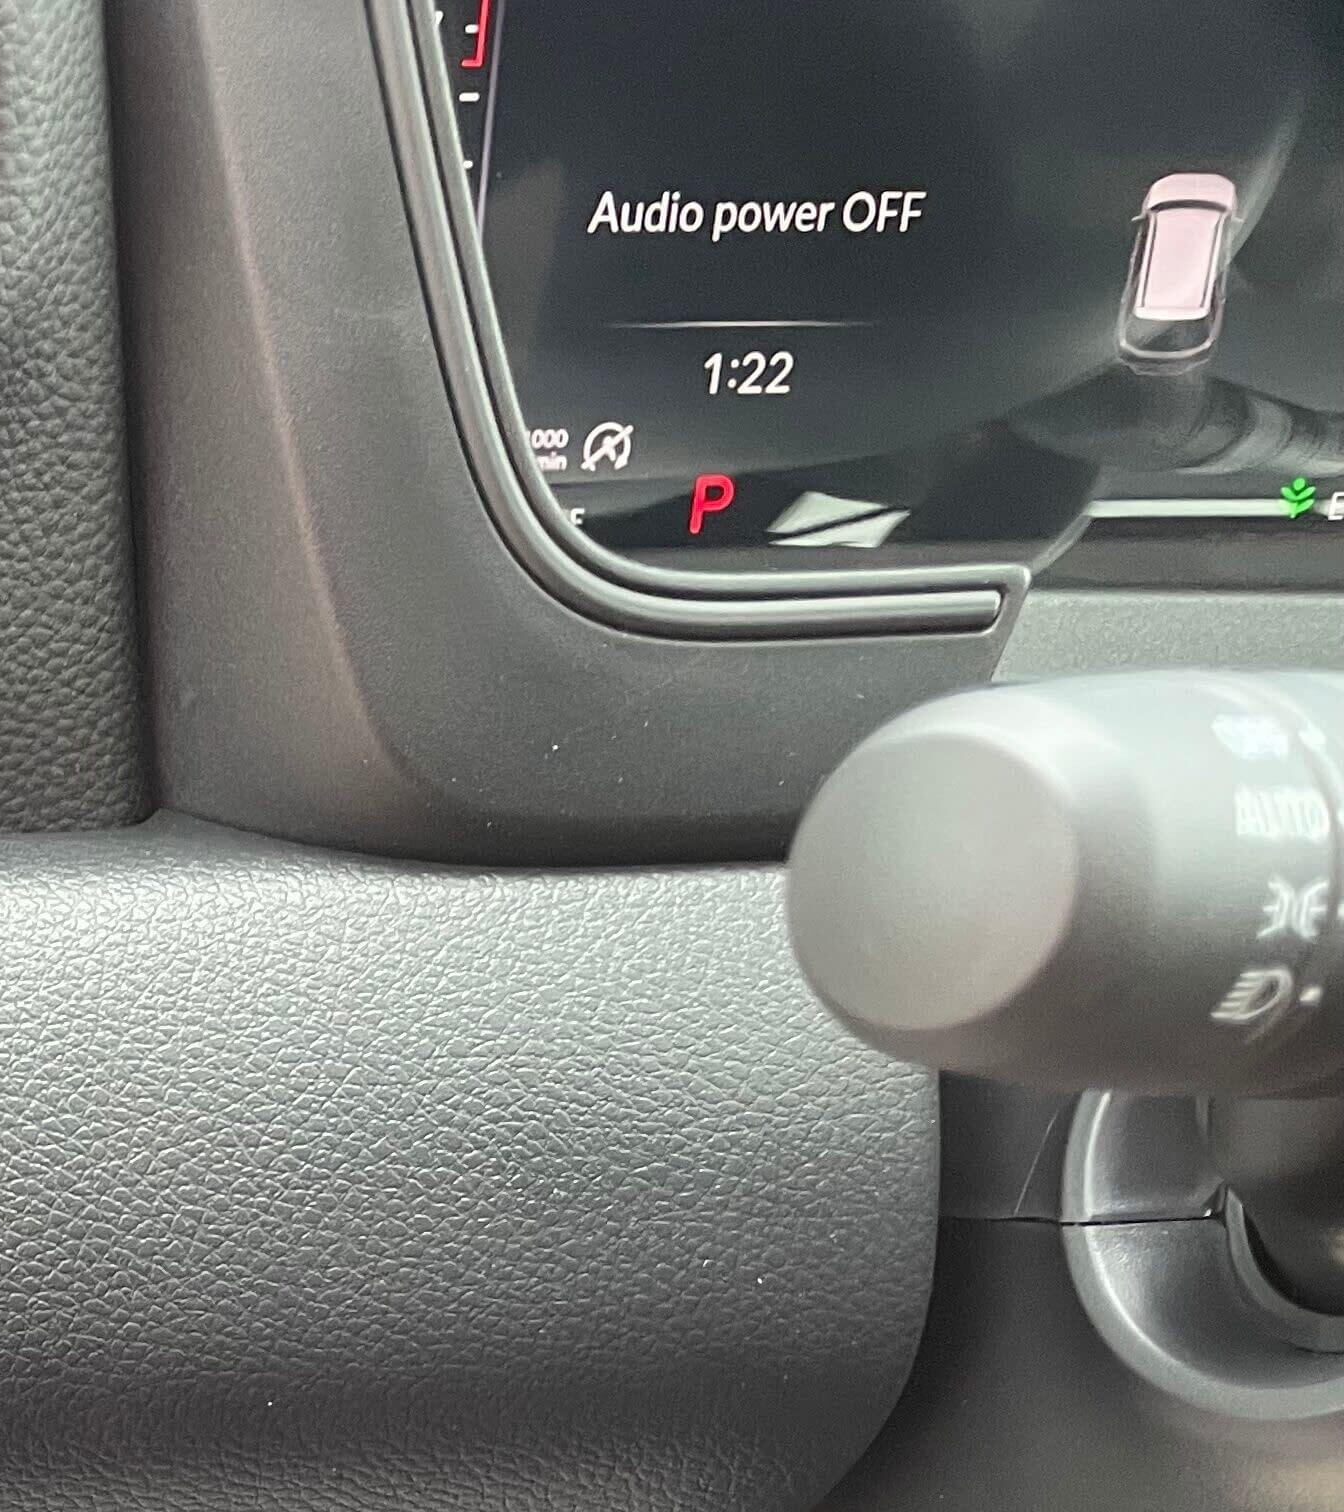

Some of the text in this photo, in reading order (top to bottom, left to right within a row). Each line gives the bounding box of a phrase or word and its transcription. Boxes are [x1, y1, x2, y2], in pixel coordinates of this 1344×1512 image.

[587, 190, 927, 243] Audio power OFF
[704, 350, 794, 395] 1:22
[688, 473, 735, 534] P
[1235, 784, 1331, 844] AUTO
